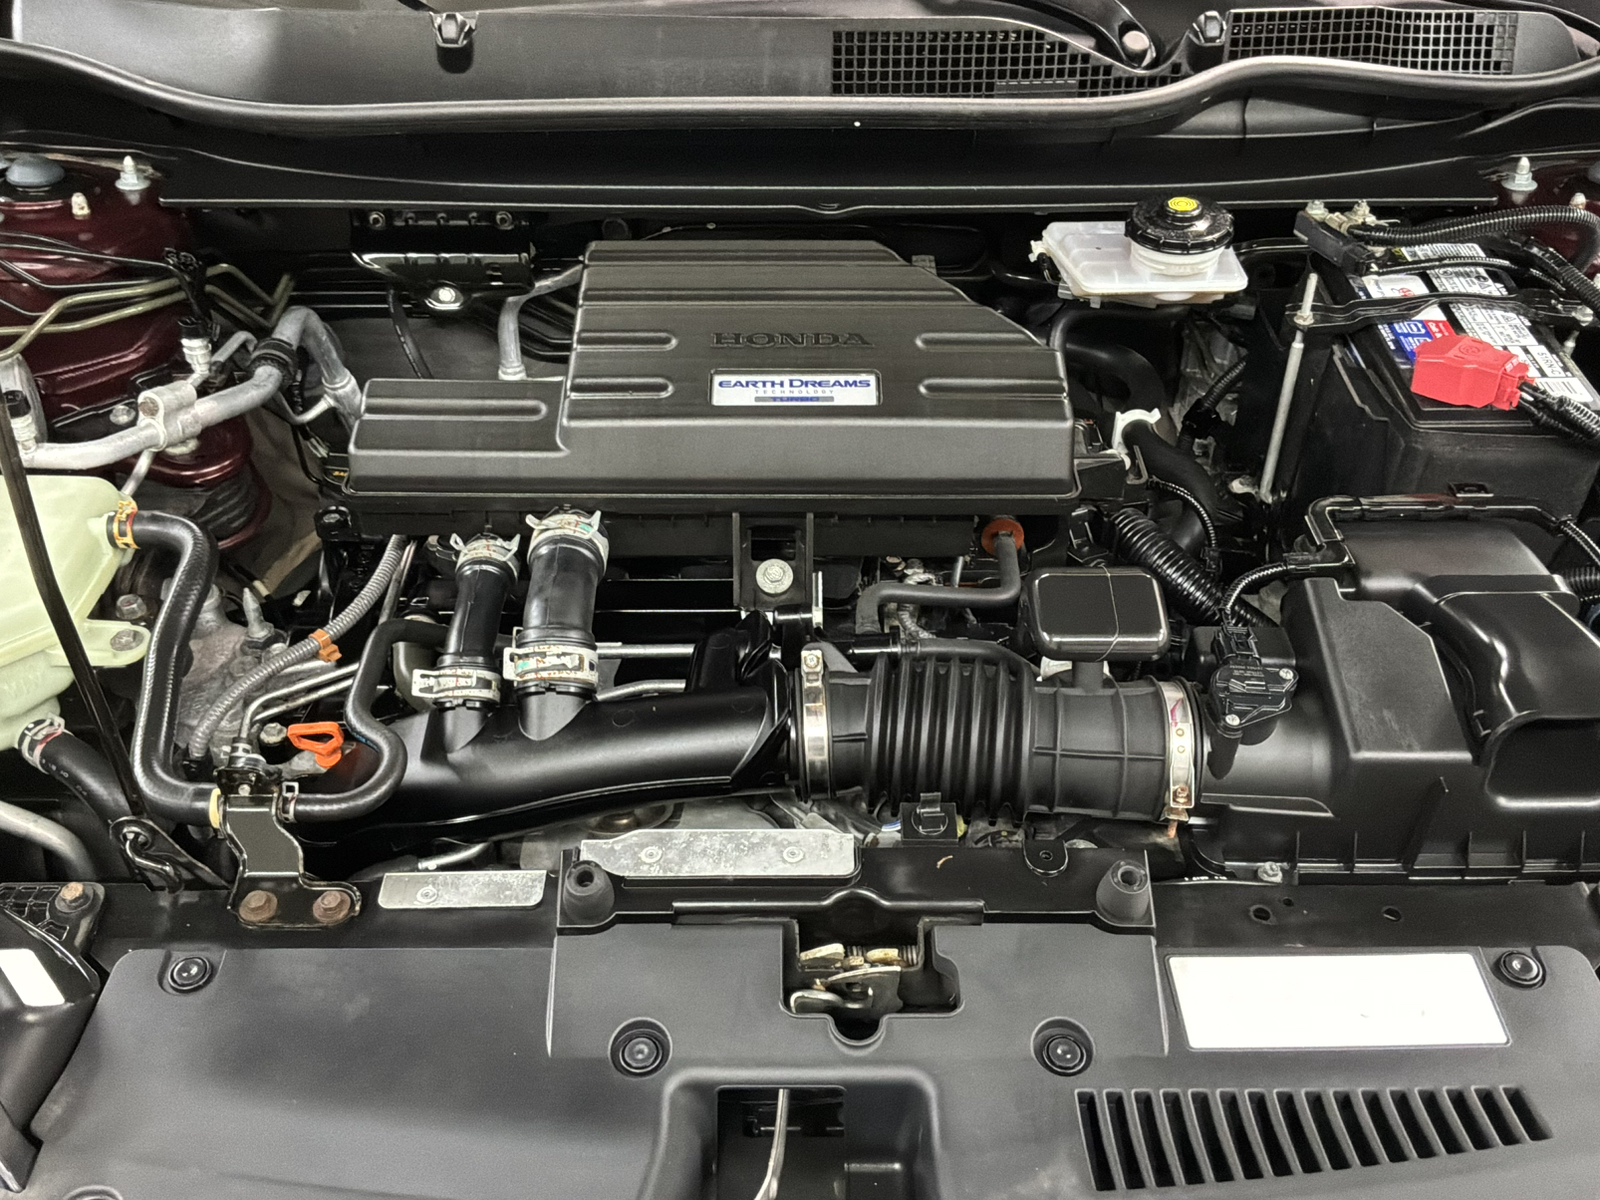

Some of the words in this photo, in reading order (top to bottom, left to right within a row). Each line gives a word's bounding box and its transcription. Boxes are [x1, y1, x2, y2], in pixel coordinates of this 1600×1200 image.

[710, 332, 875, 348] HONDA
[718, 379, 784, 388] EARTH
[788, 378, 871, 388] DREAMS
